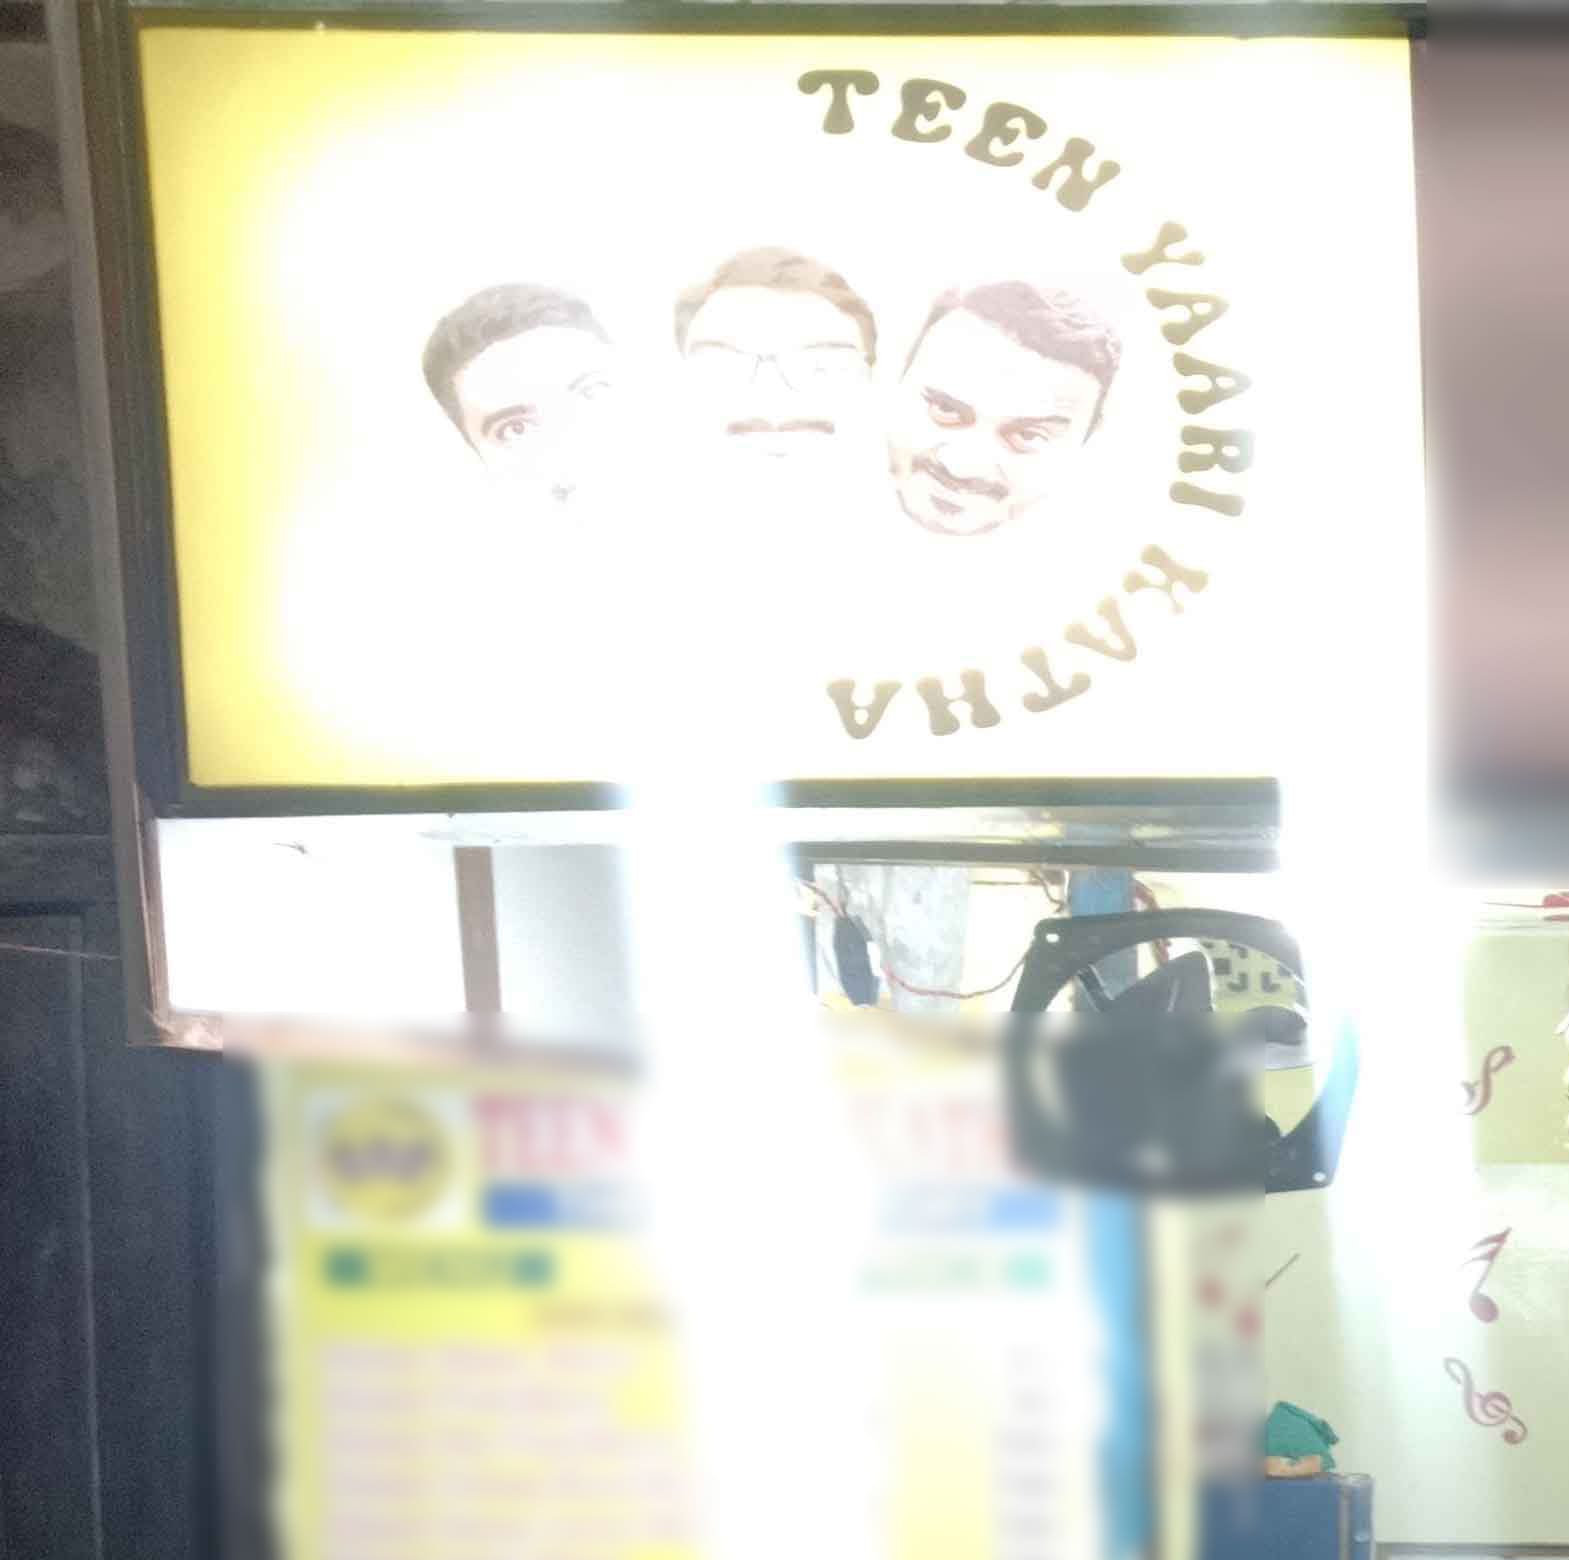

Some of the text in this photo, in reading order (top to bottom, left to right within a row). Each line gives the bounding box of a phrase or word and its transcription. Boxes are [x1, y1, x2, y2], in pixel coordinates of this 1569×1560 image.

[797, 69, 1121, 212] TEEN
[1121, 221, 1254, 517] YAARI
[827, 544, 1208, 739] KATHA
